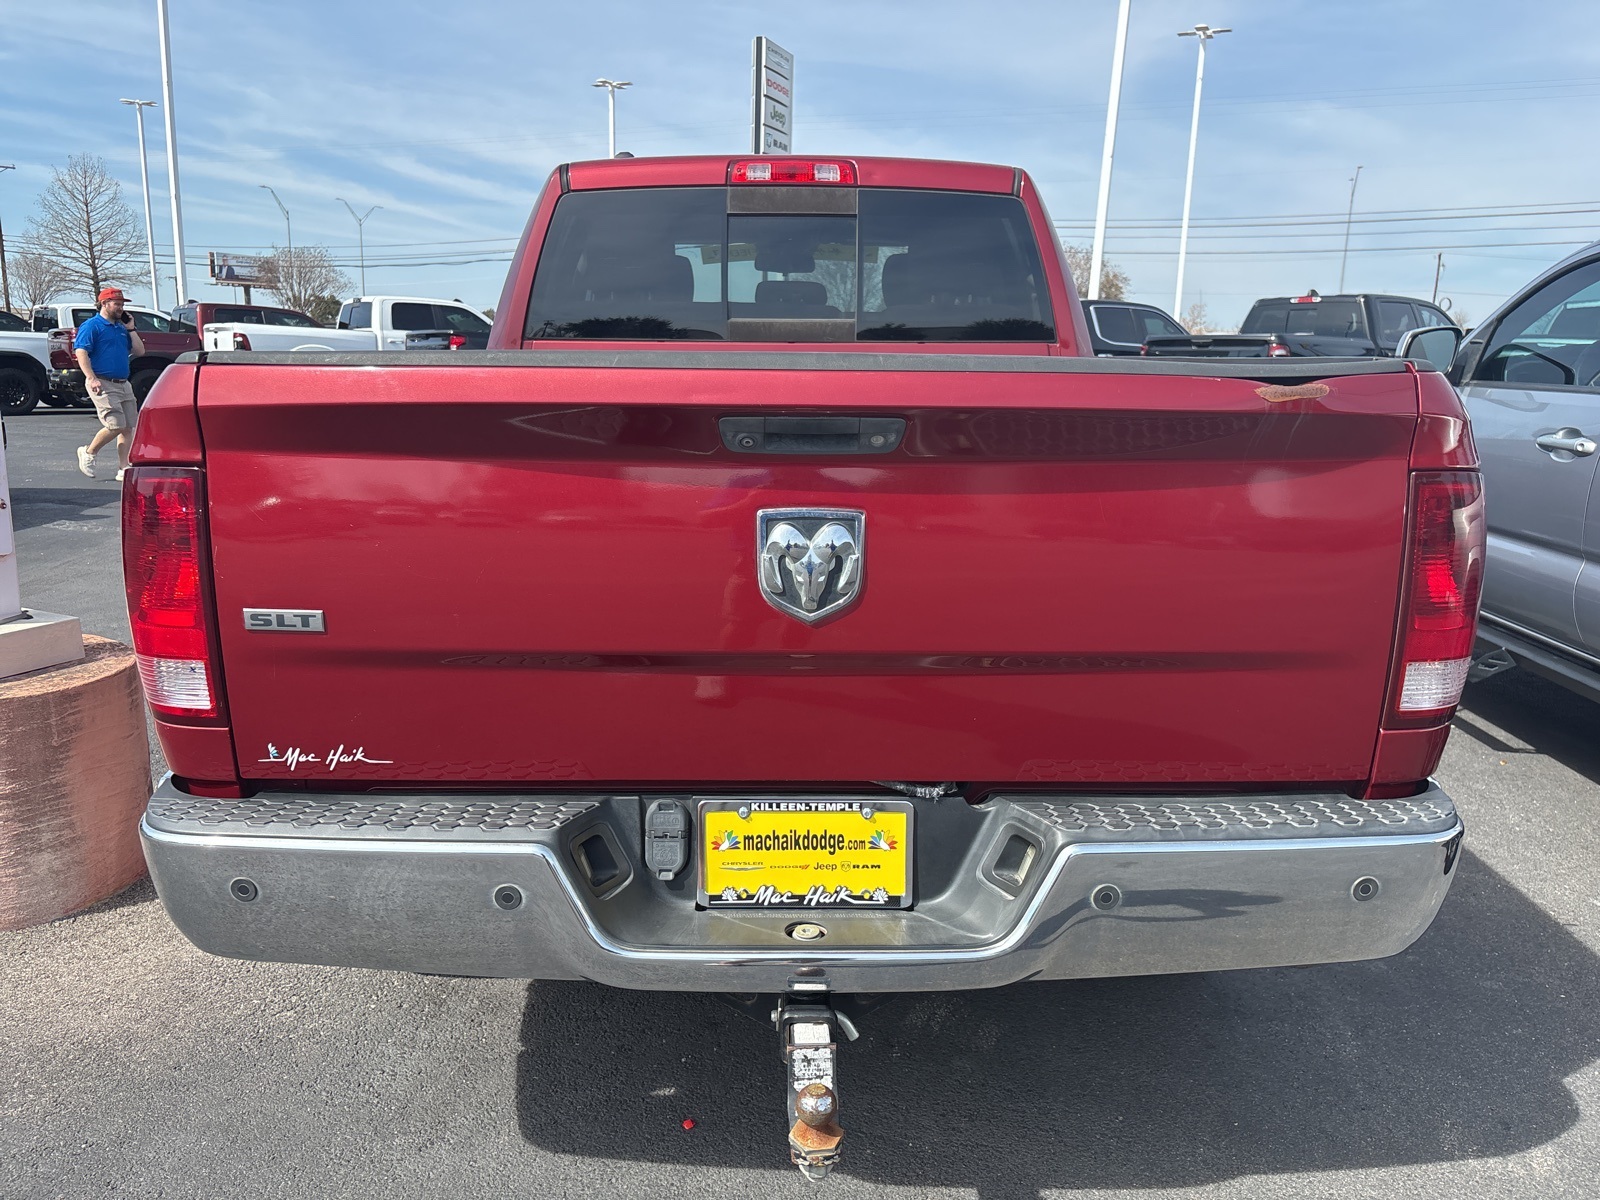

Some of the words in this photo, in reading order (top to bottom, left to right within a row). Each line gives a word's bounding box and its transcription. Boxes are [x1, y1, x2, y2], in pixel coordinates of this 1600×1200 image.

[767, 78, 789, 97] DODGE
[770, 105, 786, 128] Jeep
[250, 613, 316, 628] SLT
[283, 747, 321, 771] Mac
[326, 744, 366, 771] Haik
[751, 802, 861, 811] KILLEEN-TEMPLE
[743, 829, 866, 855] machaikdodge.com
[813, 862, 838, 871] Jeep
[753, 885, 799, 905] Mac
[804, 885, 855, 905] Haik
